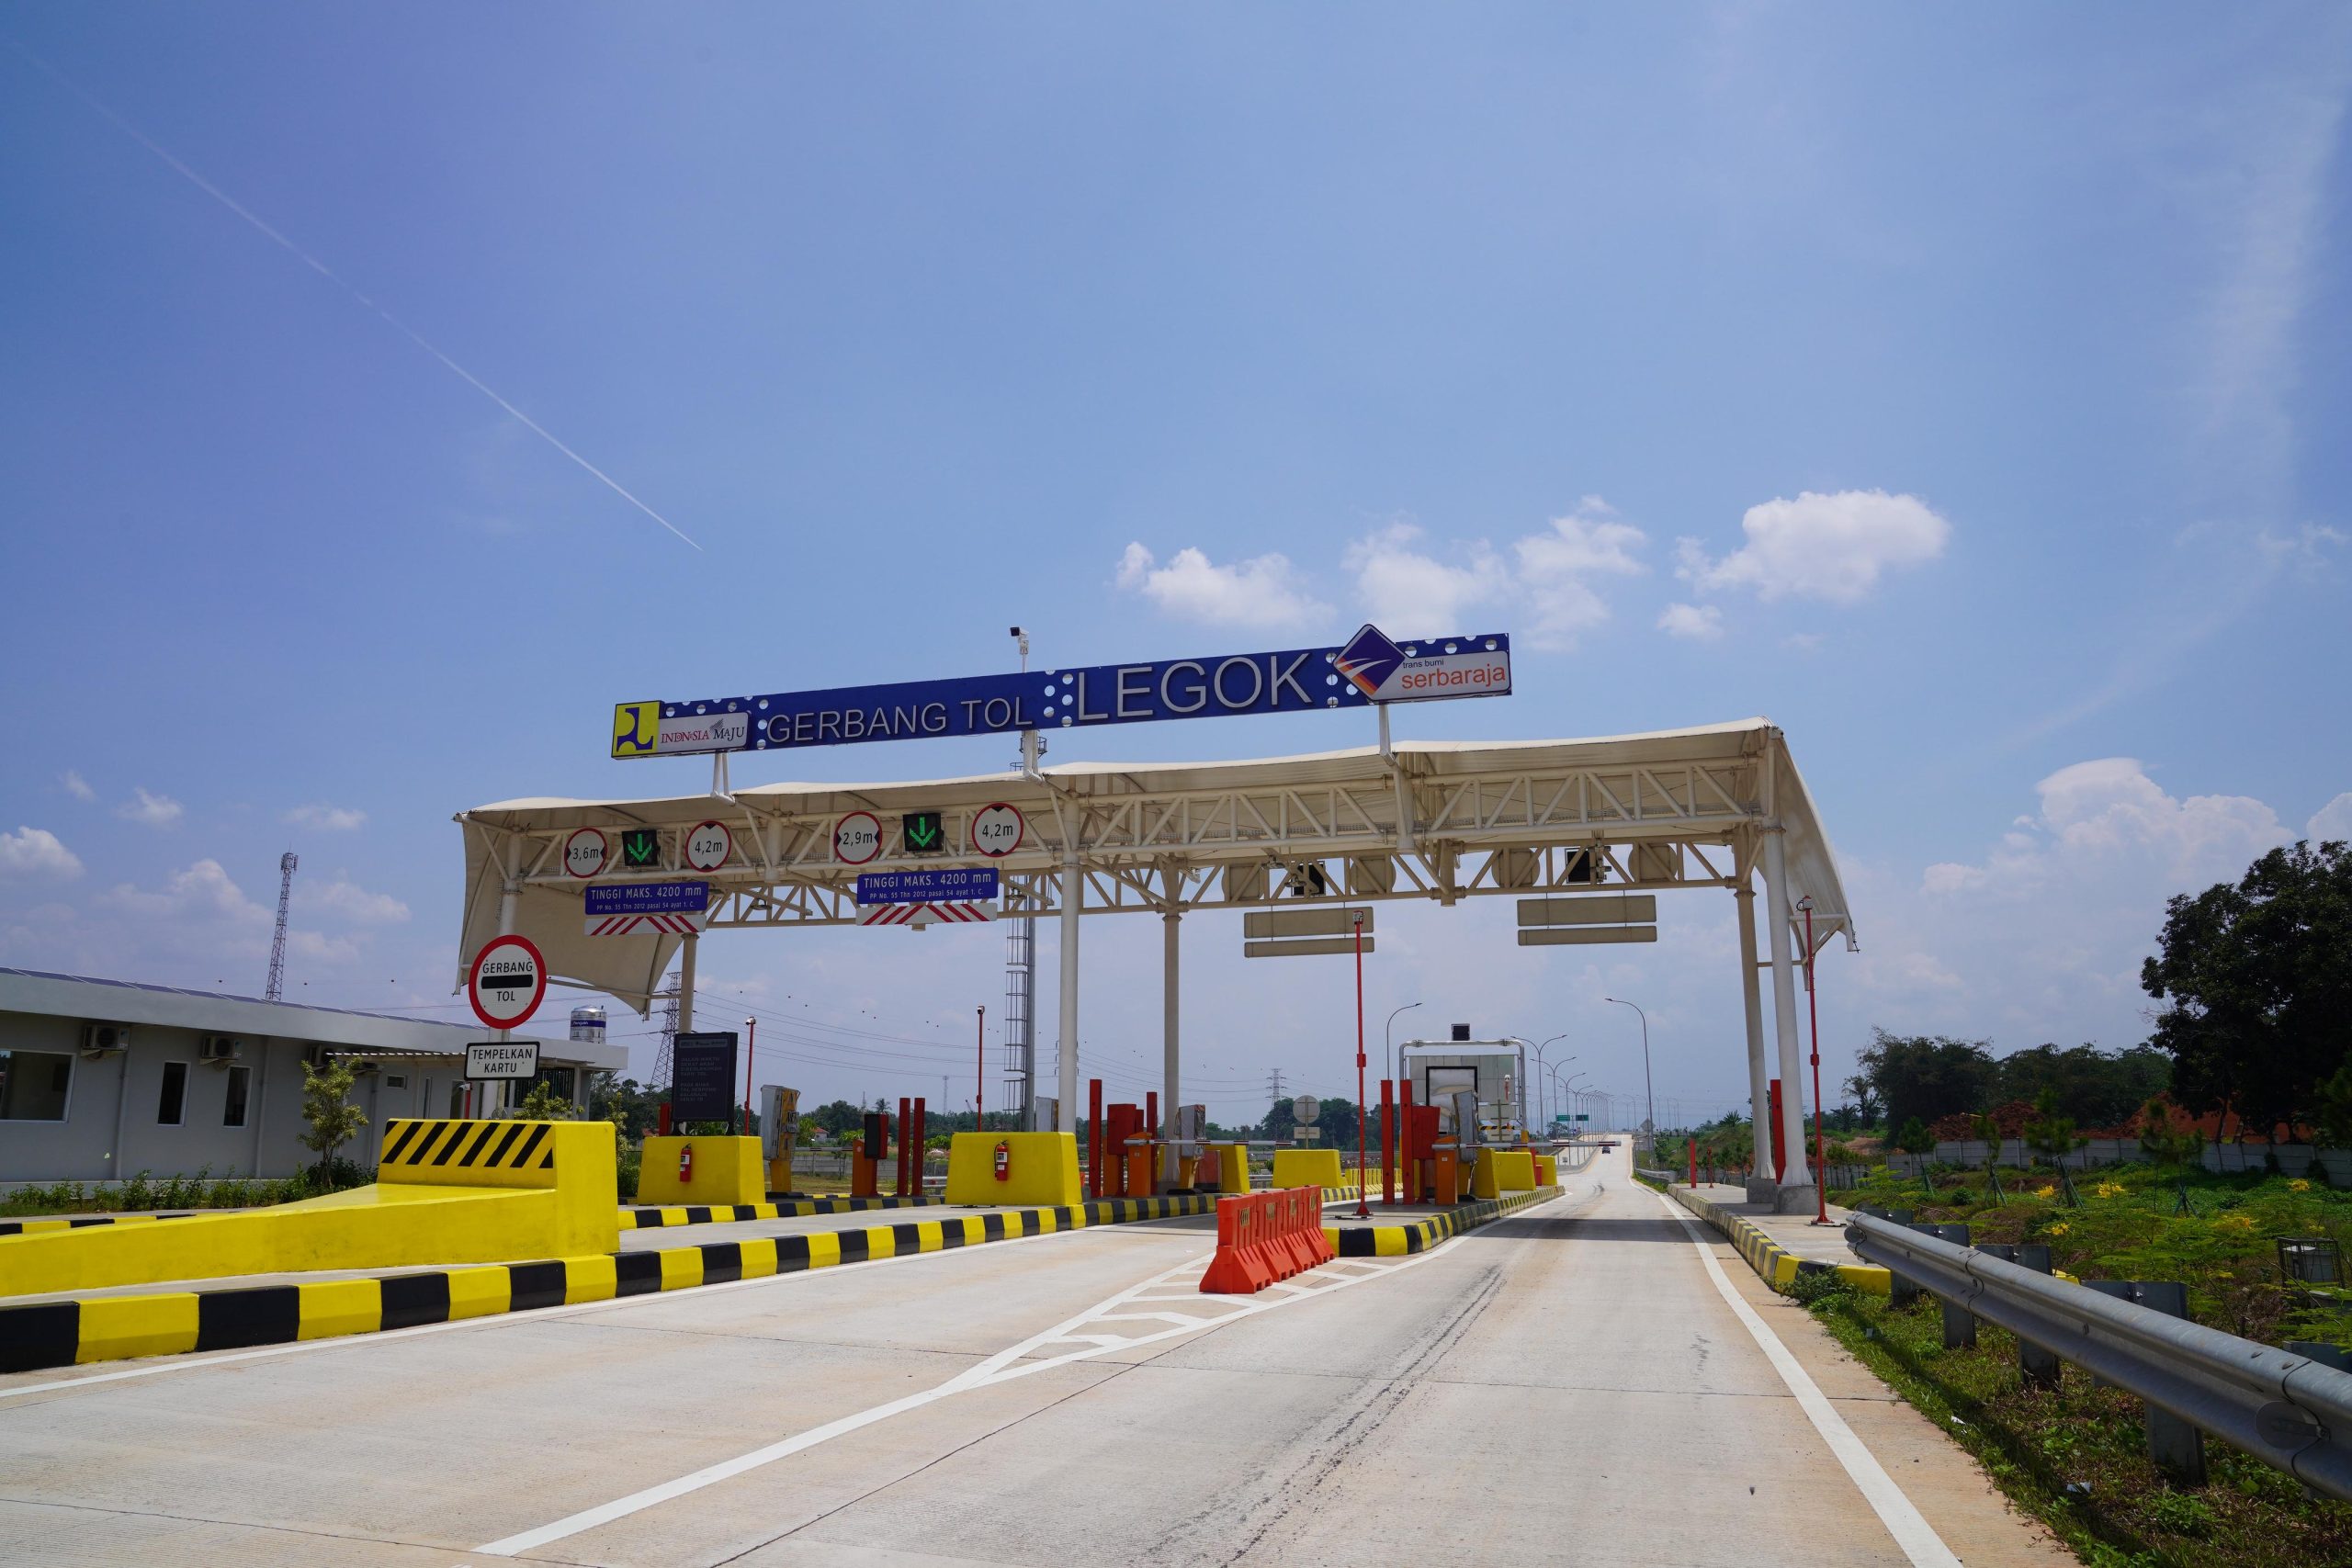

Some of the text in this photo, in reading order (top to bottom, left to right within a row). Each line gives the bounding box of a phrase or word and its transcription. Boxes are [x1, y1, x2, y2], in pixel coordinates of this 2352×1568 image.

[1424, 659, 1444, 667] bumi
[1401, 663, 1506, 689] serbaraja
[1078, 653, 1314, 721] LEGOK
[766, 696, 1033, 743] GERBANG TOL
[713, 727, 745, 741] MAJU
[981, 823, 1013, 839] 4,2m
[842, 831, 873, 847] 2,9m
[572, 847, 599, 862] 3,6m
[695, 840, 722, 856] 4,2m
[865, 873, 991, 889] TINGGI MAKS. 4200 mm
[591, 886, 702, 900] TINGGI MAKS. 4200 mm
[482, 961, 533, 974] GERBANG
[496, 991, 515, 1001] TOL
[472, 1048, 532, 1060] TEMPELKAN
[484, 1062, 516, 1073] KARTU
